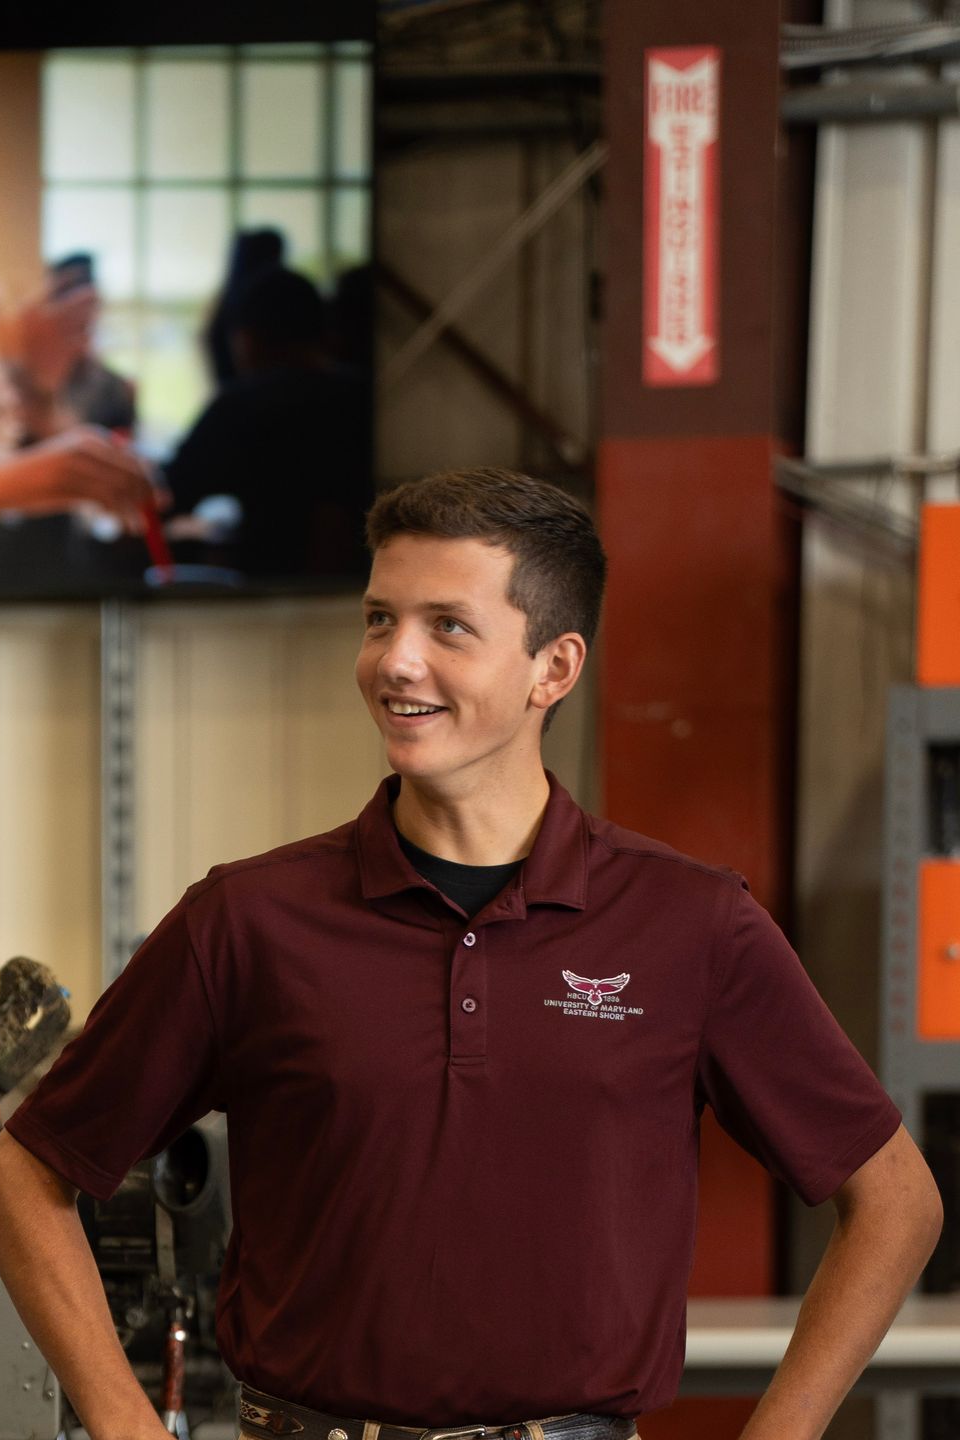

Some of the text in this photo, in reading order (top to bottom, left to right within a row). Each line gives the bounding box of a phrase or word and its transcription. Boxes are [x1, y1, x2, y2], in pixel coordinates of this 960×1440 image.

[567, 992, 588, 1000] HBCU
[544, 999, 589, 1010] UNIVERSITY
[600, 1005, 644, 1015] MARYLAND
[563, 1009, 625, 1021] EASTERN SHORE
